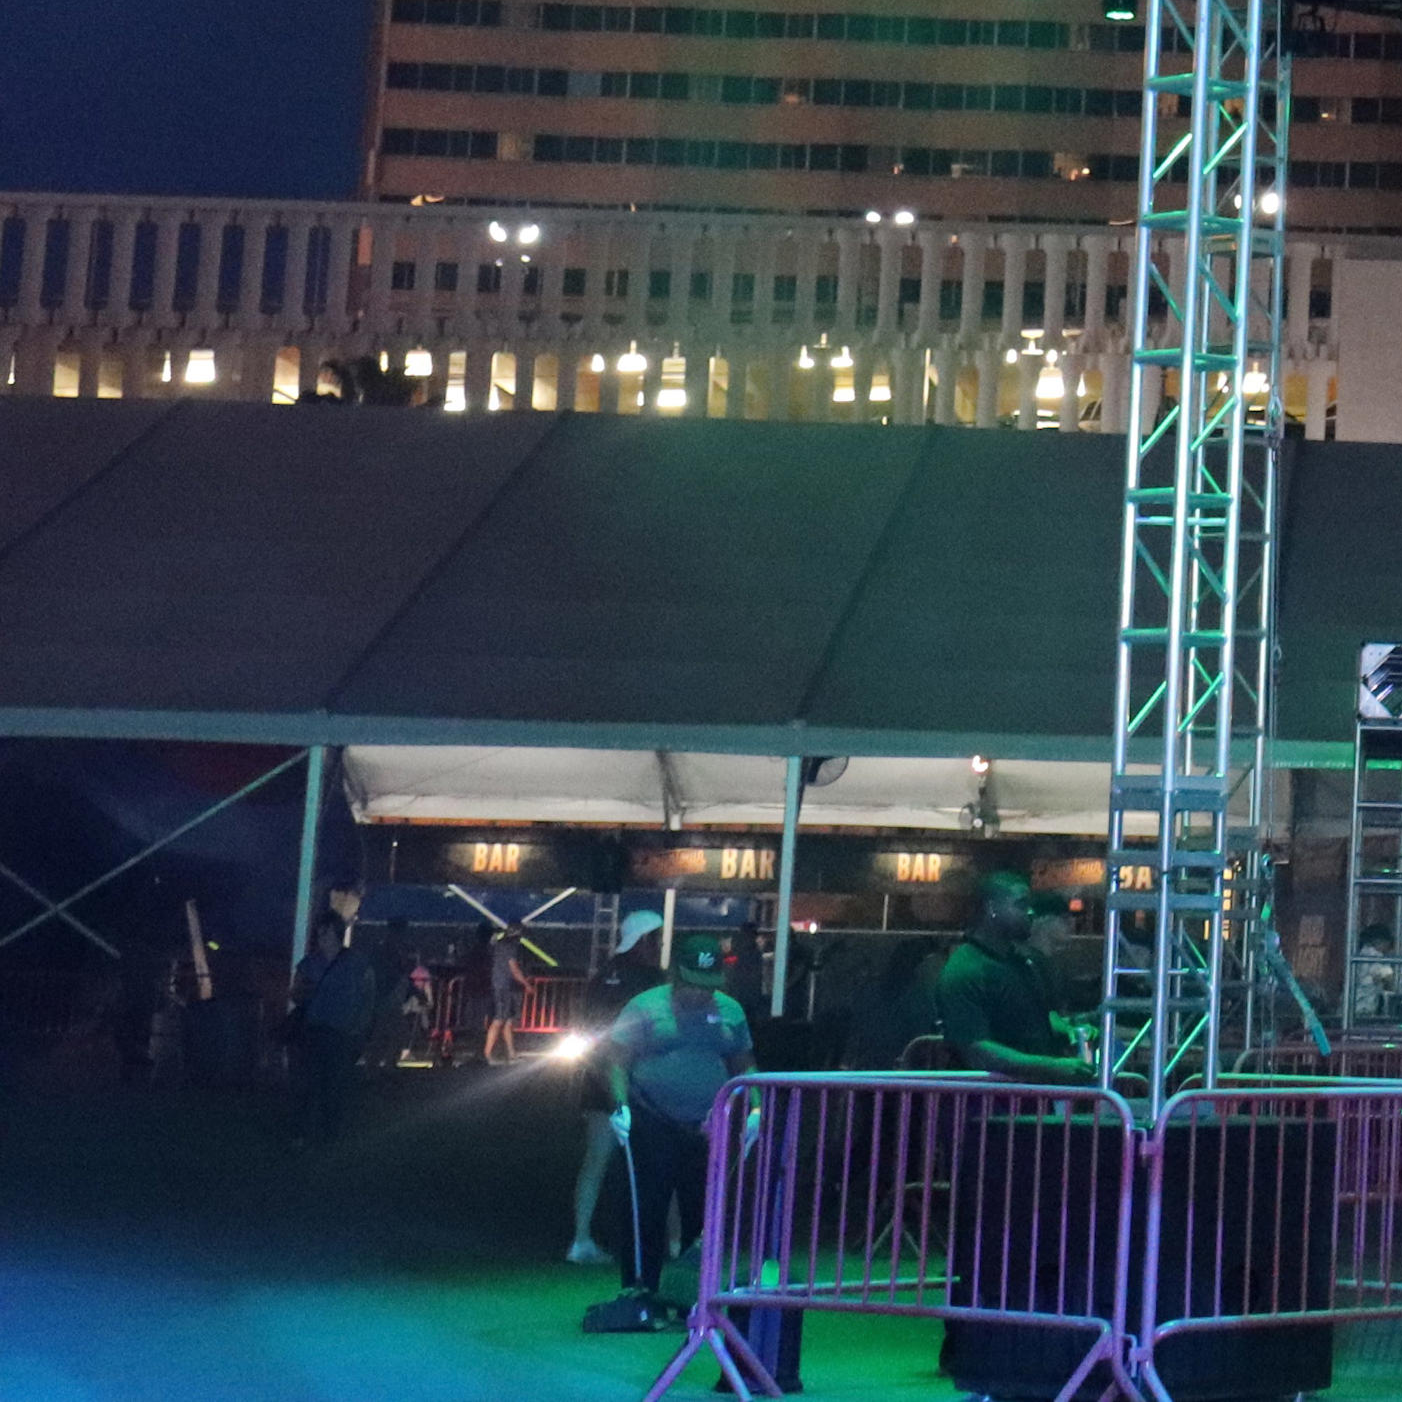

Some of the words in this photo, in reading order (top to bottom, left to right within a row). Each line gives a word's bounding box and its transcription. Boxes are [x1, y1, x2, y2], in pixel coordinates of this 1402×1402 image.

[473, 843, 520, 873] BAR
[720, 848, 776, 880] BAR
[897, 853, 942, 883] BAR
